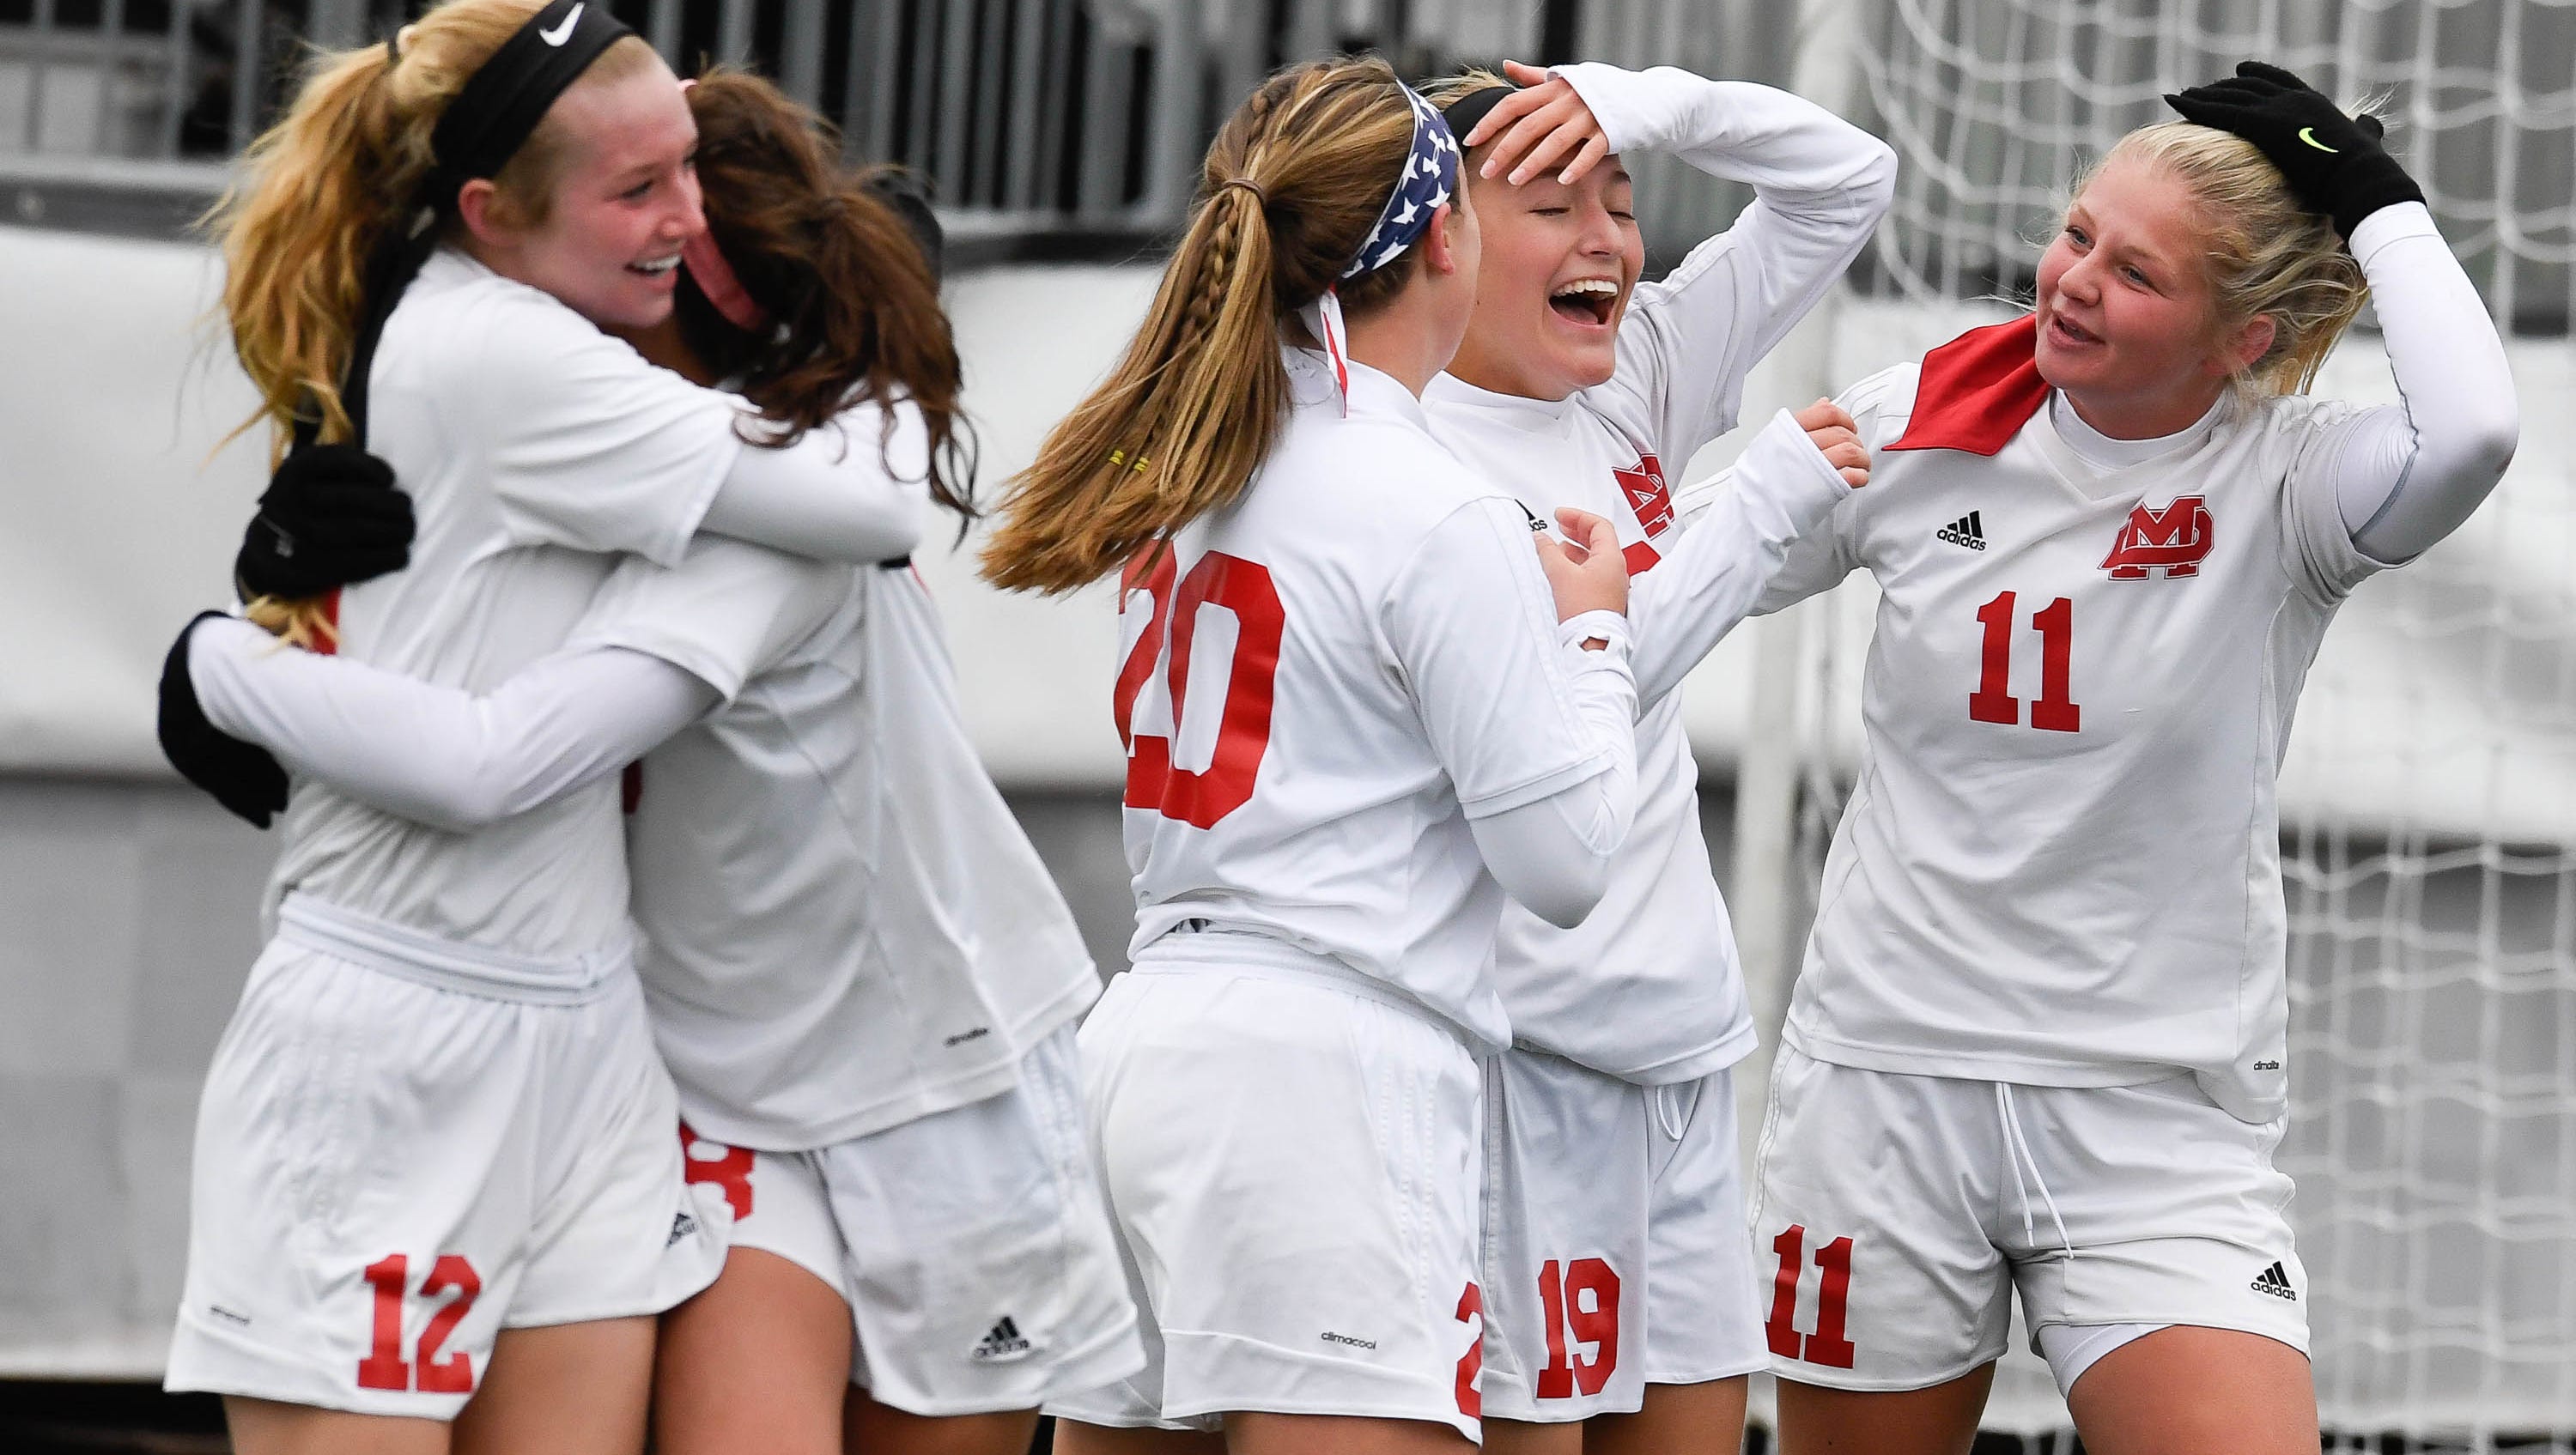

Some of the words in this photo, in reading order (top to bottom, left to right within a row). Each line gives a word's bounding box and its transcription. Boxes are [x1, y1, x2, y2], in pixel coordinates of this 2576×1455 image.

[1936, 528, 1987, 551] adidas
[1113, 537, 1285, 831] 20
[1970, 590, 2081, 733] 11
[357, 1253, 482, 1392] 12
[1321, 1331, 1377, 1350] climacool
[1536, 1258, 1620, 1399] 19
[1765, 1223, 1856, 1369] 11
[2251, 1281, 2297, 1301] adidas
